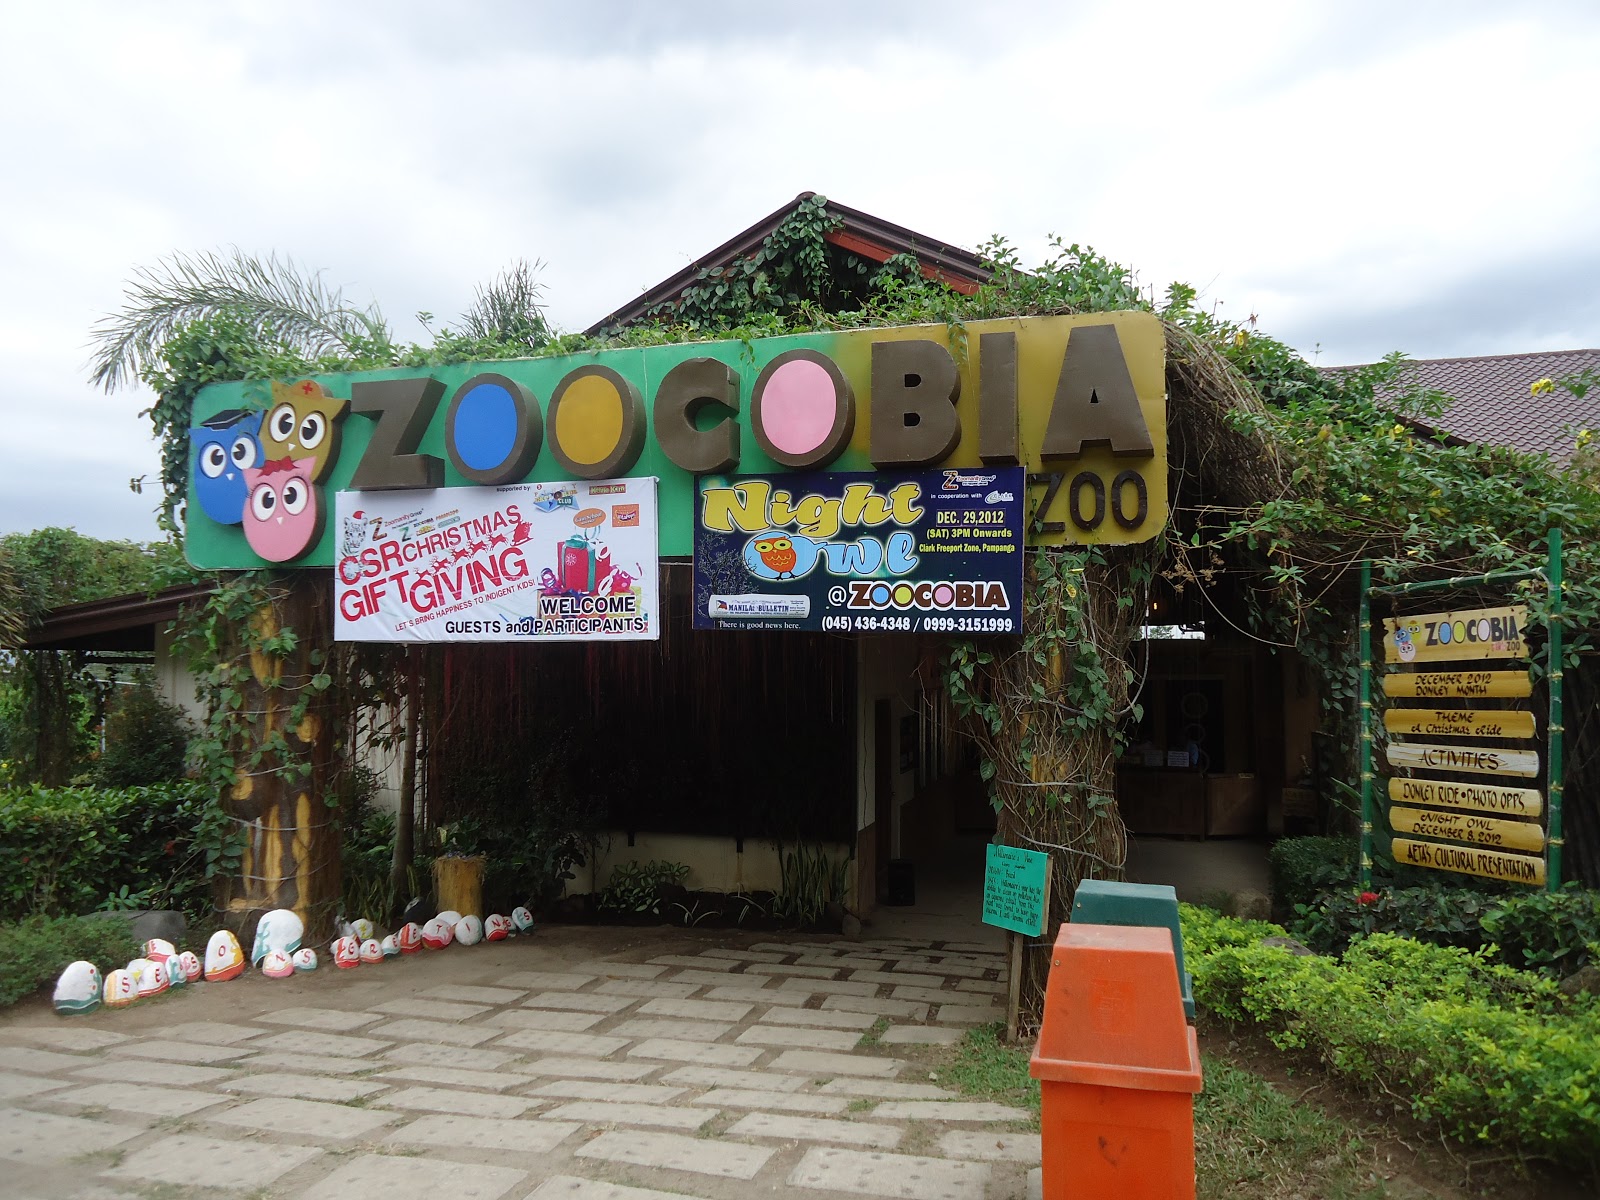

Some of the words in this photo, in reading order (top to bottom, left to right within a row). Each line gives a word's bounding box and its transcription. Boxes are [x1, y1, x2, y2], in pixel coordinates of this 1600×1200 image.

[349, 324, 1154, 490] ZOOCOBIA
[702, 481, 925, 538] Night
[1026, 469, 1148, 531] ZOO
[937, 511, 960, 524] DEC.
[963, 511, 1004, 526] 29,2012
[926, 529, 950, 539] (SAT)
[951, 529, 971, 538] 3PM
[972, 528, 1013, 538] Onwards
[338, 540, 405, 586] CSR
[402, 504, 522, 563] CHRISTMAS
[919, 543, 936, 553] Clark
[936, 543, 963, 554] Freeport
[963, 543, 982, 554] Zone,
[982, 543, 1016, 554] Pampanga
[339, 570, 409, 622] GIFT
[409, 547, 530, 614] GIVING
[415, 613, 436, 625] BRING
[436, 600, 473, 620] HAPPINESS
[474, 596, 484, 606] TO
[485, 585, 516, 602] INDIGENT
[516, 579, 536, 591] KIDS!
[541, 596, 636, 615] WELCOME
[758, 605, 790, 613] BULLETIN
[445, 620, 501, 634] GUESTS
[505, 620, 530, 633] and
[534, 617, 645, 634] PARTICIPANTS
[718, 620, 738, 628] There
[746, 621, 764, 630] good
[784, 621, 801, 629] here.
[821, 616, 852, 632] (045)
[854, 616, 911, 631] 436-4348
[923, 617, 1013, 632] 0999-3151999
[1424, 615, 1520, 647] ZOOCOBIA
[1506, 641, 1521, 652] ZOO
[1415, 673, 1463, 685] DECEMBER
[1467, 673, 1492, 685] 2012
[1415, 685, 1449, 697] DONKEY
[1456, 684, 1487, 696] MONTH
[1435, 711, 1475, 723] THEME
[1425, 723, 1471, 735] Christmas
[1418, 749, 1500, 771] ACTIVITIES
[1403, 782, 1435, 802] DONKEY
[1438, 786, 1460, 805] RIDE
[1466, 788, 1498, 808] PHOTO
[1420, 812, 1461, 825] NIGHT
[1466, 818, 1495, 831] OWL
[1412, 822, 1463, 840] DECEMBER
[1478, 831, 1503, 845] 2012
[1434, 847, 1477, 872] CULTURAL
[1477, 854, 1537, 881] PRESENTATION
